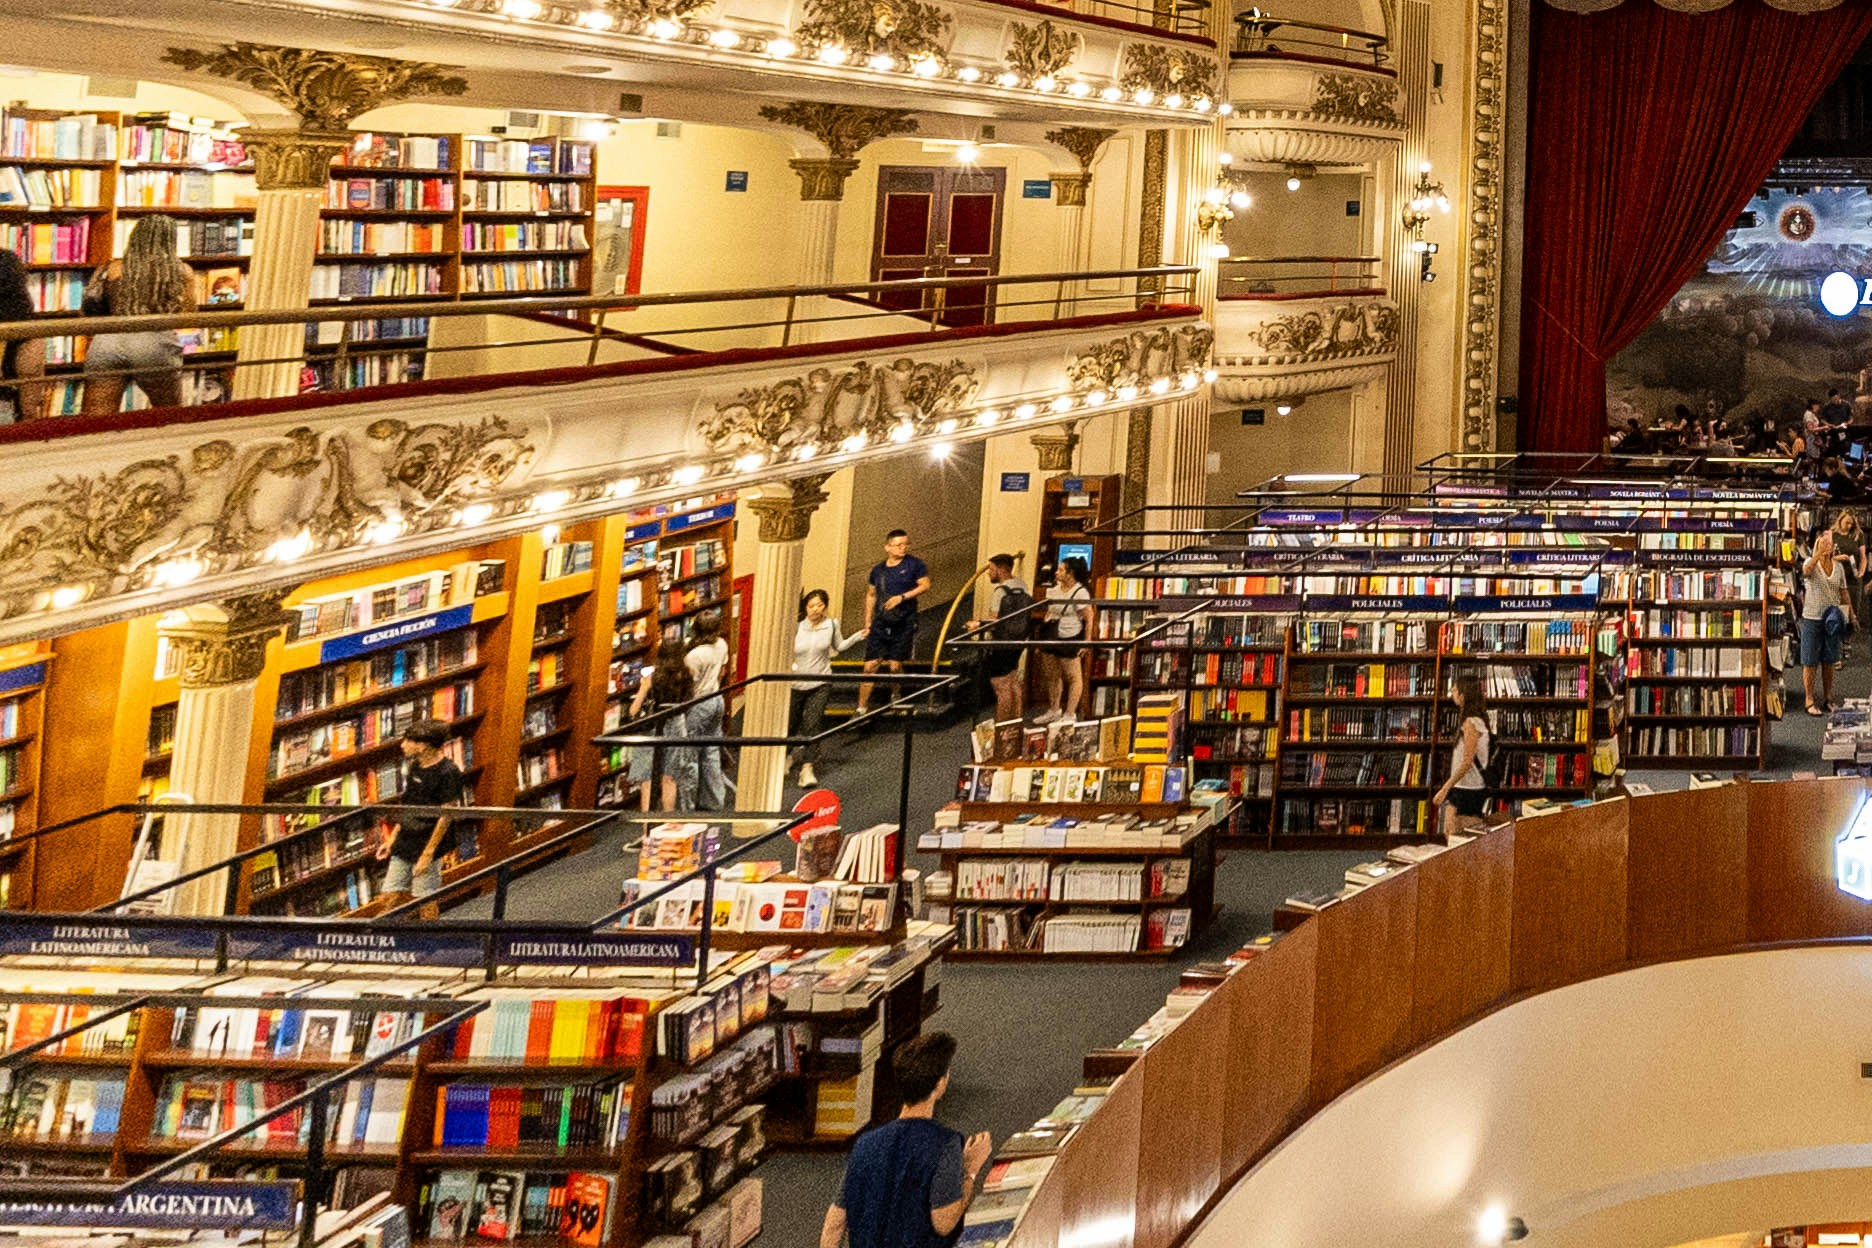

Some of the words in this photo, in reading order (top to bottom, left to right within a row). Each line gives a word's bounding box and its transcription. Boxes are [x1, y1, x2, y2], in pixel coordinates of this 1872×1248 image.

[1712, 491, 1738, 499] NOVELA
[1288, 514, 1316, 522] TEATRO
[1693, 554, 1704, 562] DE
[1705, 554, 1752, 562] ESCRITORES
[1351, 599, 1403, 608] POLICIALES
[1500, 599, 1552, 609] POLICIALES
[53, 926, 130, 939] LITERATURA
[317, 933, 396, 947] LITERATURA
[30, 941, 150, 956] LATINOAMERICANA
[293, 947, 417, 963] LATINOAMERICANA
[510, 942, 577, 957] LITERATURA
[577, 943, 680, 958] LATINOAMERICANA
[118, 1193, 255, 1217] ARGENTINA
